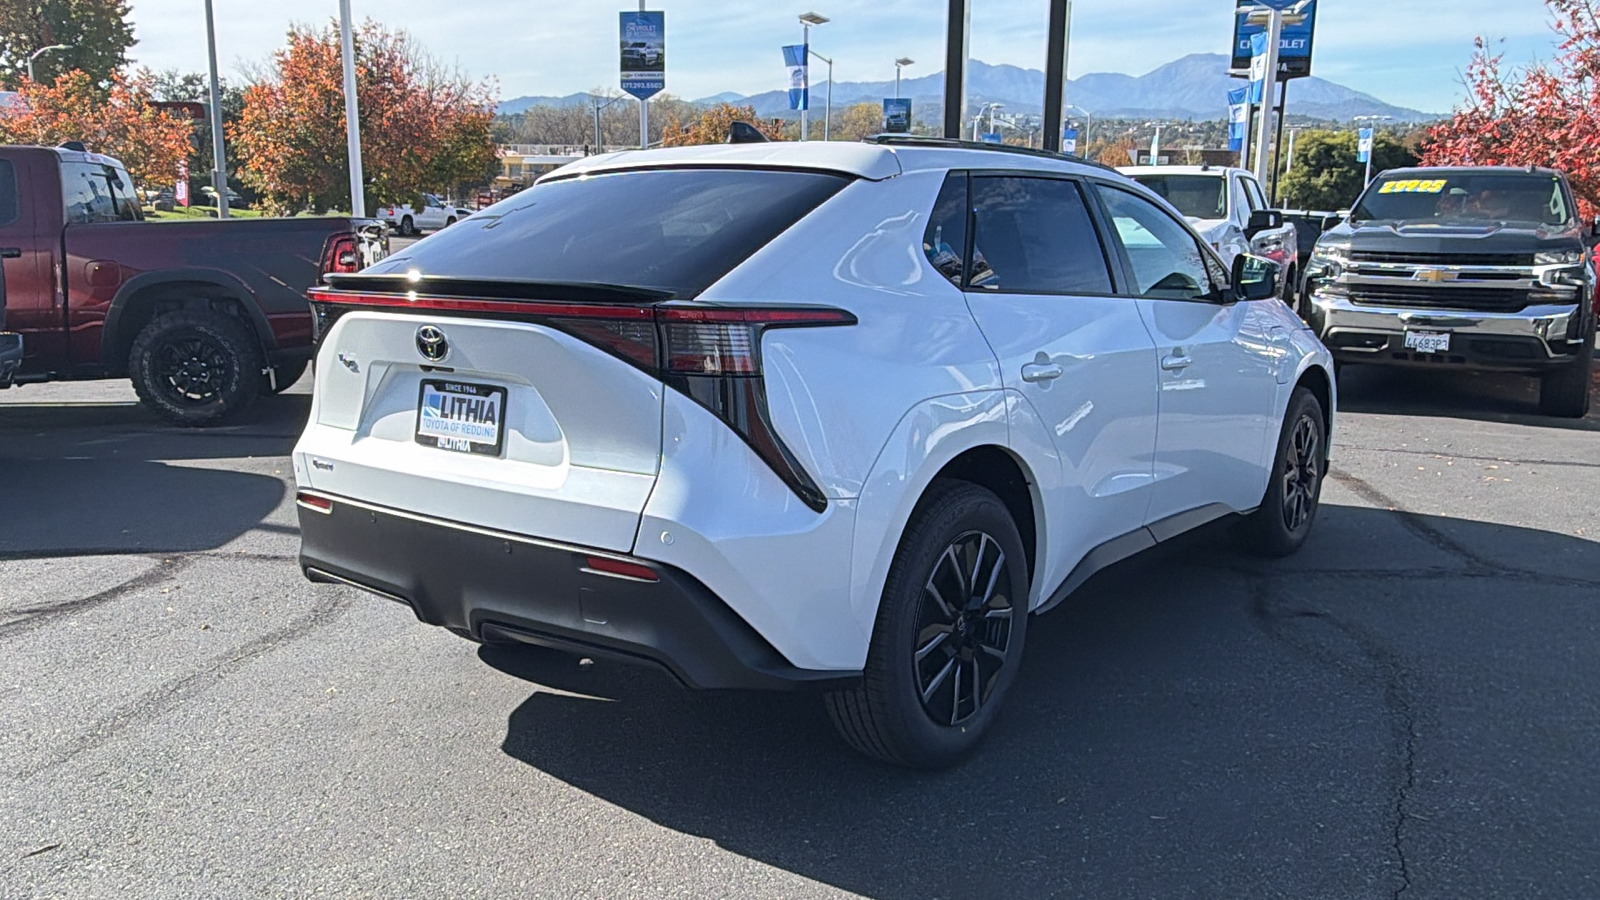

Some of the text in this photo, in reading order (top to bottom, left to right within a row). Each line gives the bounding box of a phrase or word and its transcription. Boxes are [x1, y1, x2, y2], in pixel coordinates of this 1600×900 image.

[445, 383, 477, 394] SINCE 1946
[440, 395, 496, 426] LITHIA
[423, 418, 496, 437] TOYOTA OF REDDING
